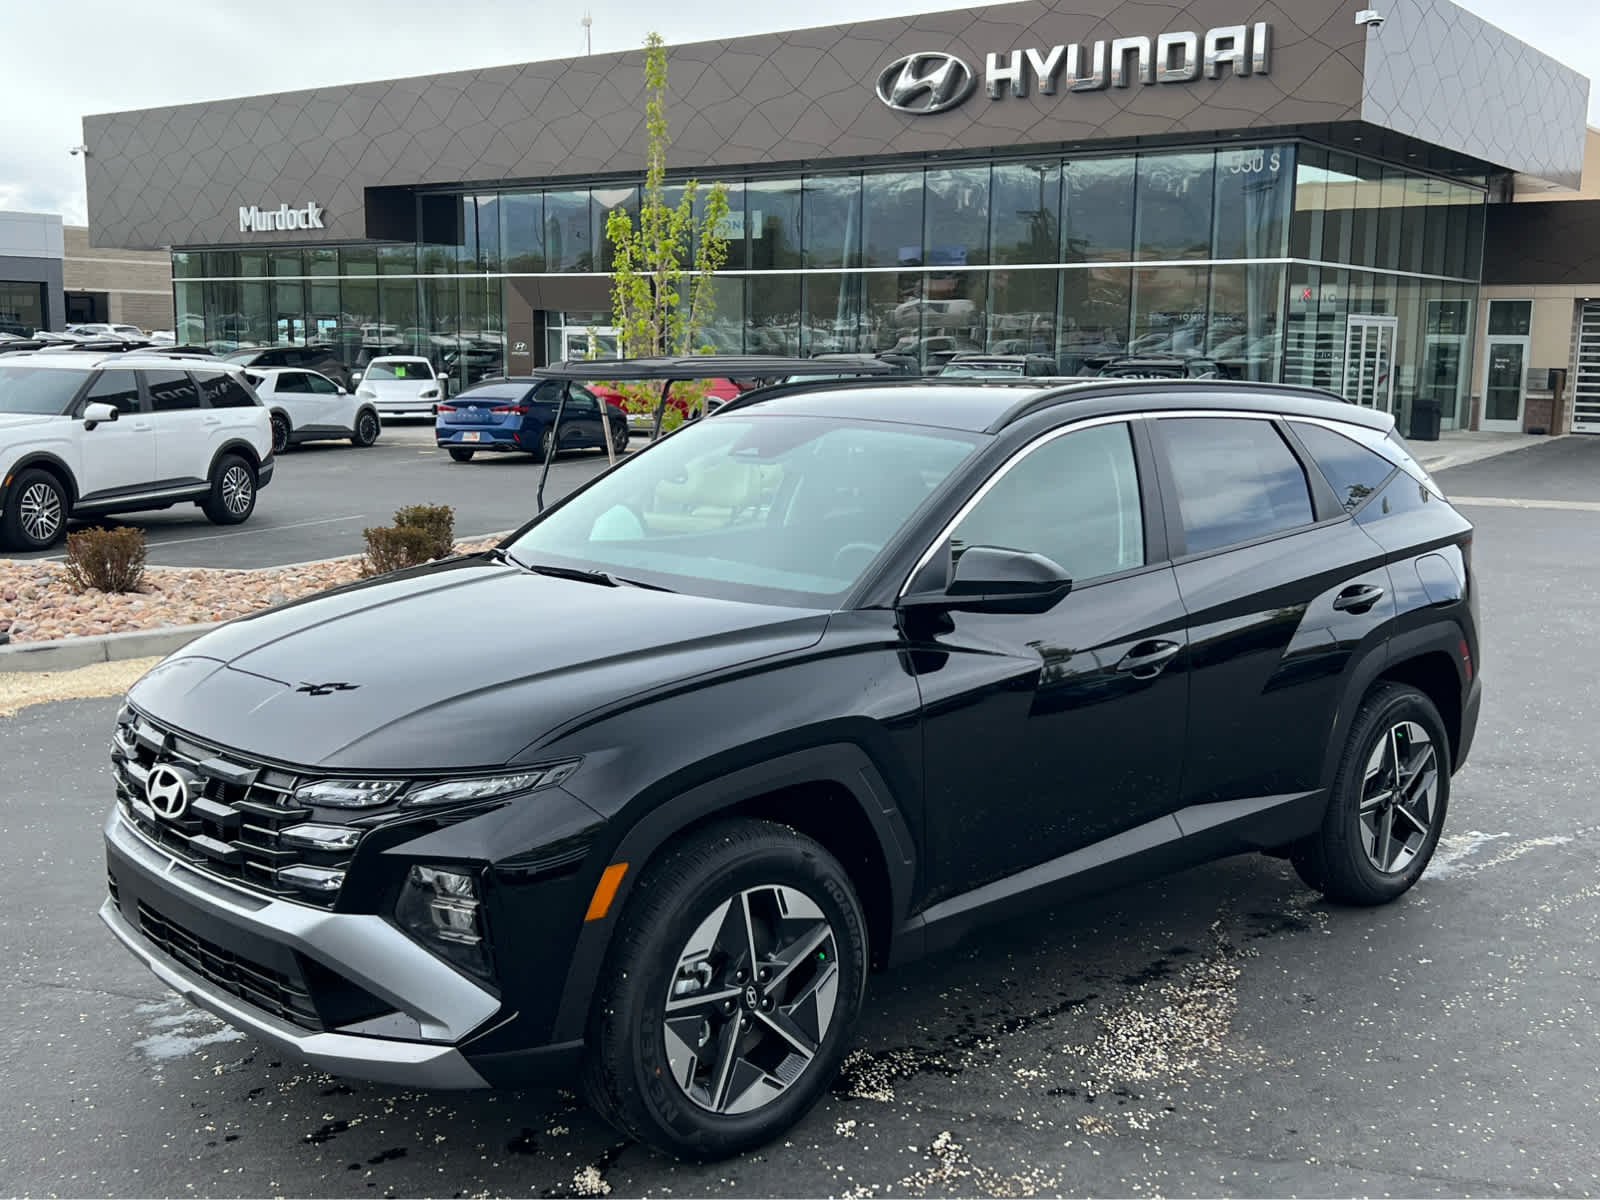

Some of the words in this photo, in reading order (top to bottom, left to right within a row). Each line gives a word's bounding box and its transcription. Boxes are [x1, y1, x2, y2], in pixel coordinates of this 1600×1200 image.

[985, 22, 1270, 99] HYUNDAI
[1269, 152, 1280, 172] S
[239, 201, 324, 232] Murdock
